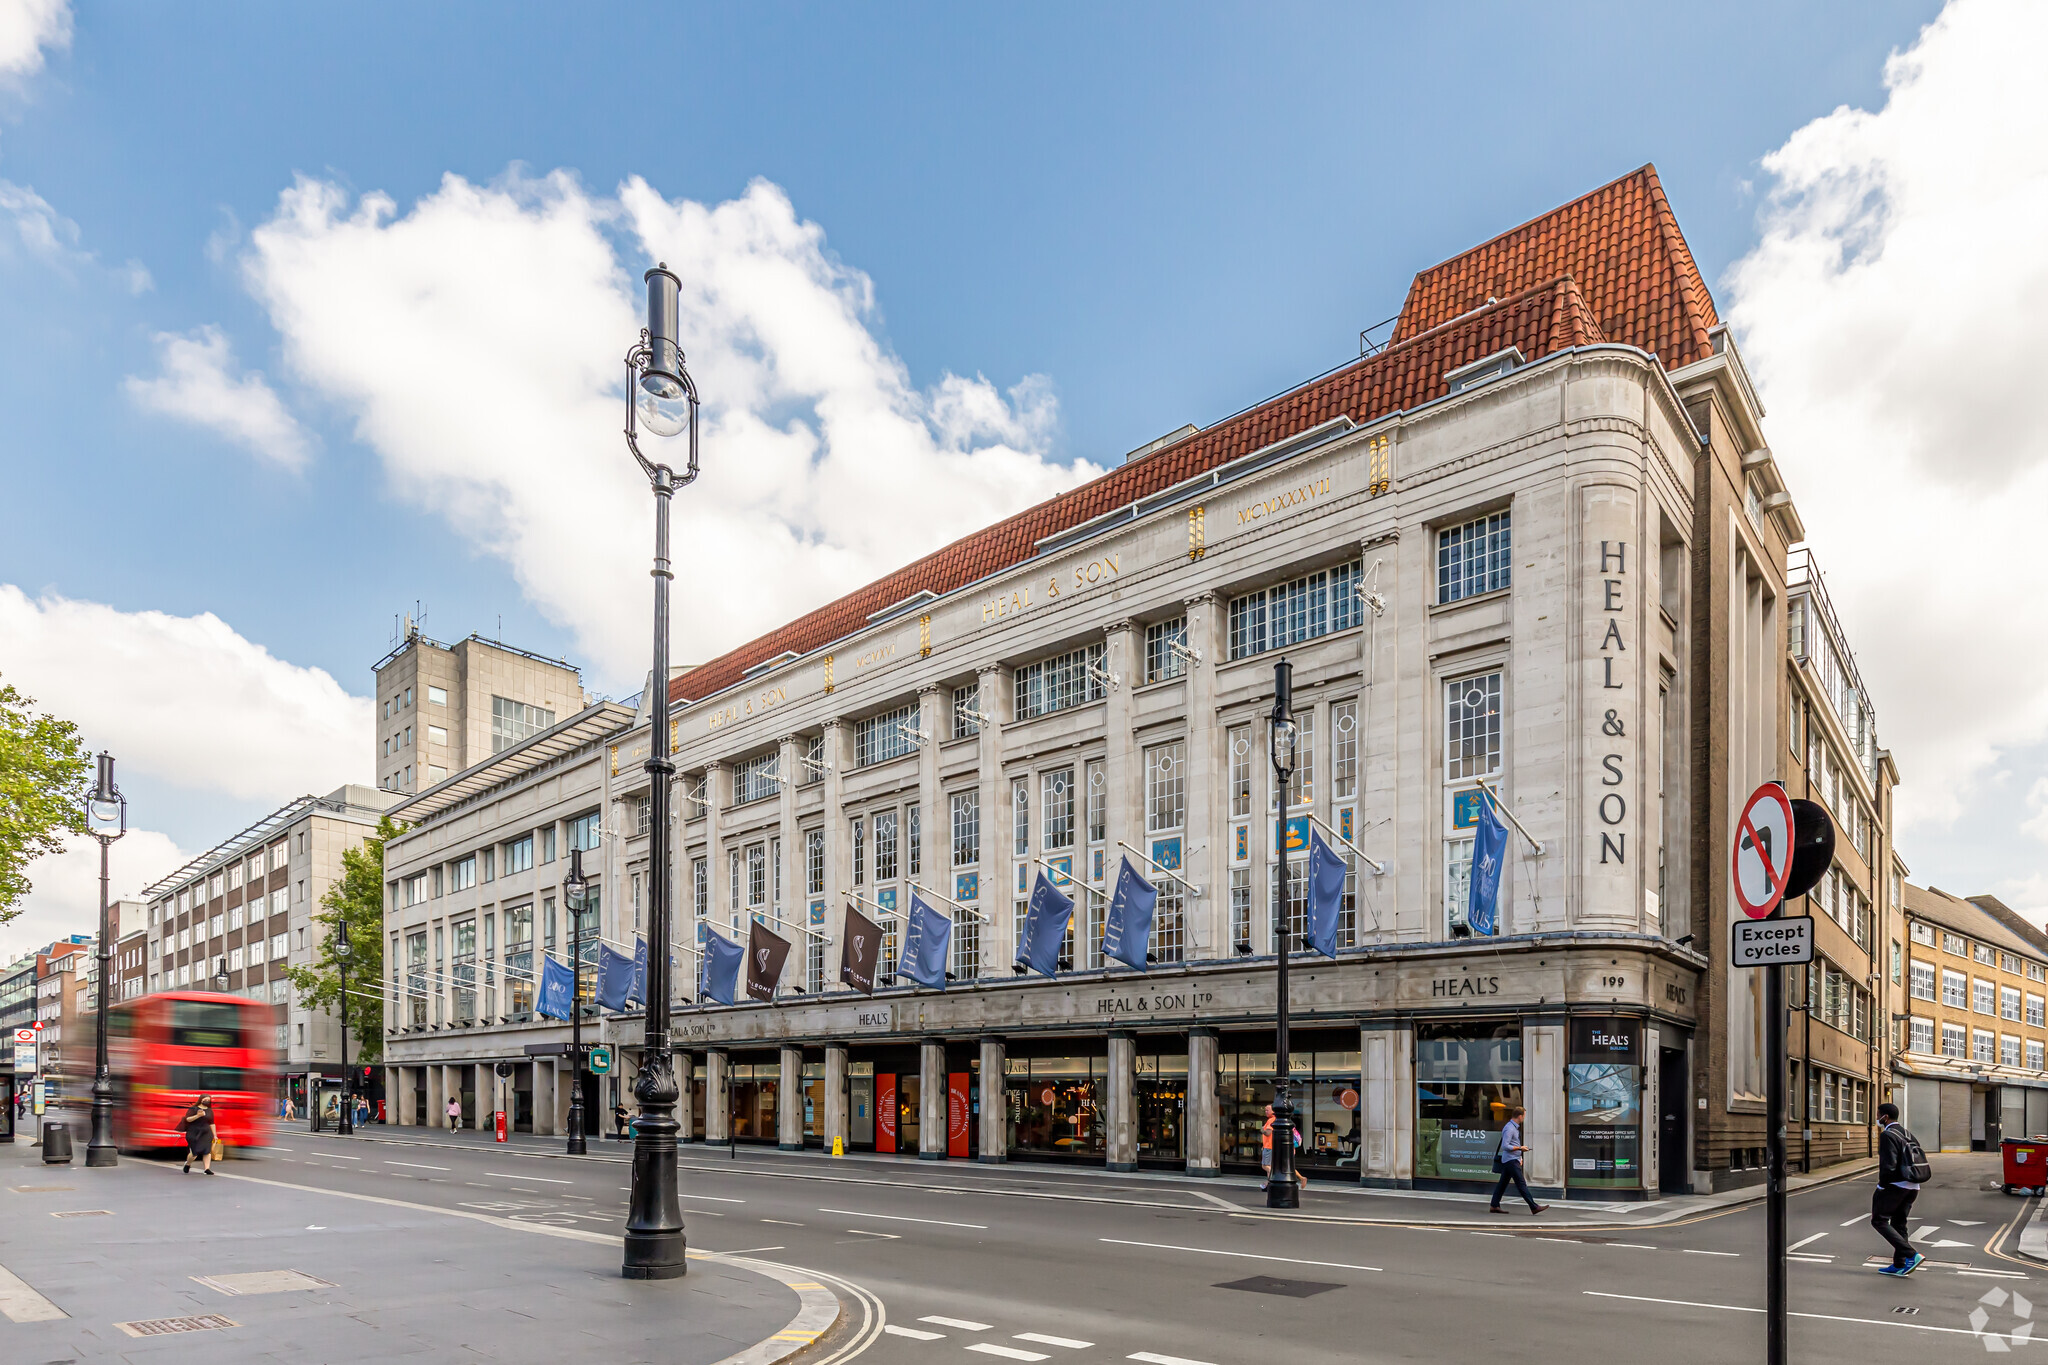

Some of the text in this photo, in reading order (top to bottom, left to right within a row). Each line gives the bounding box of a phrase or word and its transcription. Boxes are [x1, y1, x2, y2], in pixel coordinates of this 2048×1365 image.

[1237, 477, 1330, 525] MCMXXXVII
[983, 553, 1120, 623] HEAL & SON
[856, 643, 896, 669] MCMXVI
[709, 686, 787, 730] HEAL & SON
[1599, 540, 1627, 864] HEAL & SON
[901, 903, 925, 976] HEAL'S
[1742, 924, 1805, 942] Except
[1744, 942, 1801, 960] cycles
[1431, 976, 1500, 998] HEAL'S
[1602, 976, 1625, 988] 199
[1097, 997, 1133, 1014] HEAL
[1137, 997, 1148, 1011] &
[1154, 994, 1186, 1010] SON
[858, 1012, 888, 1026] HEAL'S
[670, 1027, 682, 1037] EAL
[683, 1026, 689, 1036] &
[690, 1025, 705, 1036] SON
[566, 1044, 594, 1053] HAL'S
[1591, 1035, 1629, 1046] HEAL'S
[1271, 1060, 1308, 1070] HAL'S
[1449, 1129, 1486, 1139] HEAL'S
